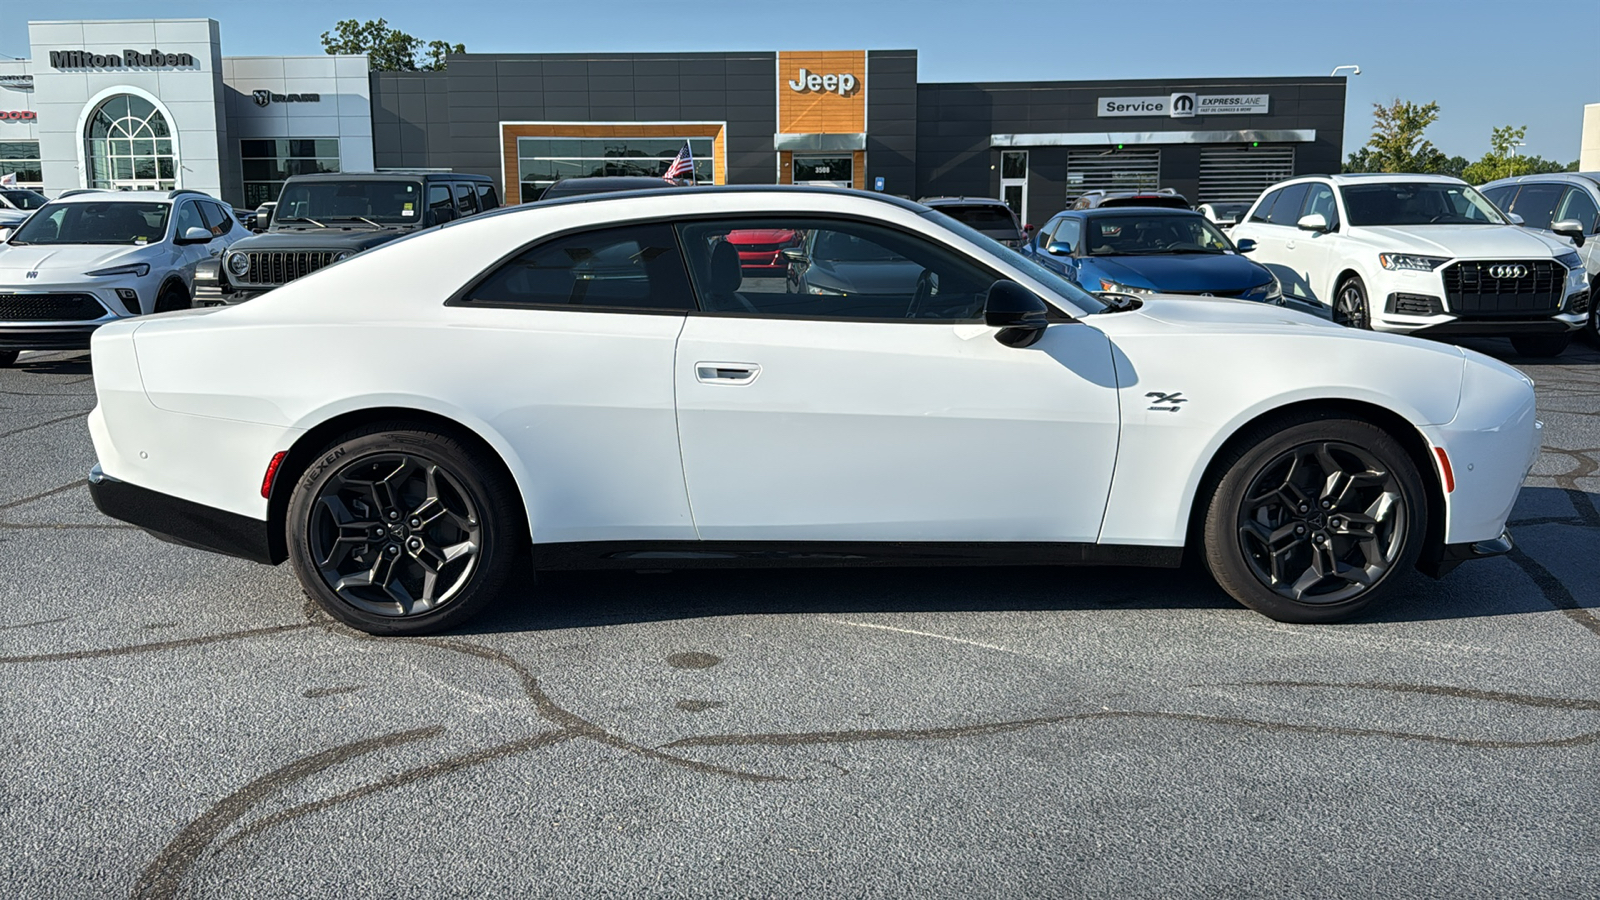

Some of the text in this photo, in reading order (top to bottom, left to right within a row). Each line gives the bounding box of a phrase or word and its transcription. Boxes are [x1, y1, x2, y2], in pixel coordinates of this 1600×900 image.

[49, 49, 193, 68] Milton Ruben
[788, 68, 855, 95] Jeep
[1106, 101, 1164, 112] Service
[0, 110, 37, 120] DOD
[815, 166, 831, 174] 3508
[303, 447, 345, 491] NEXEN
